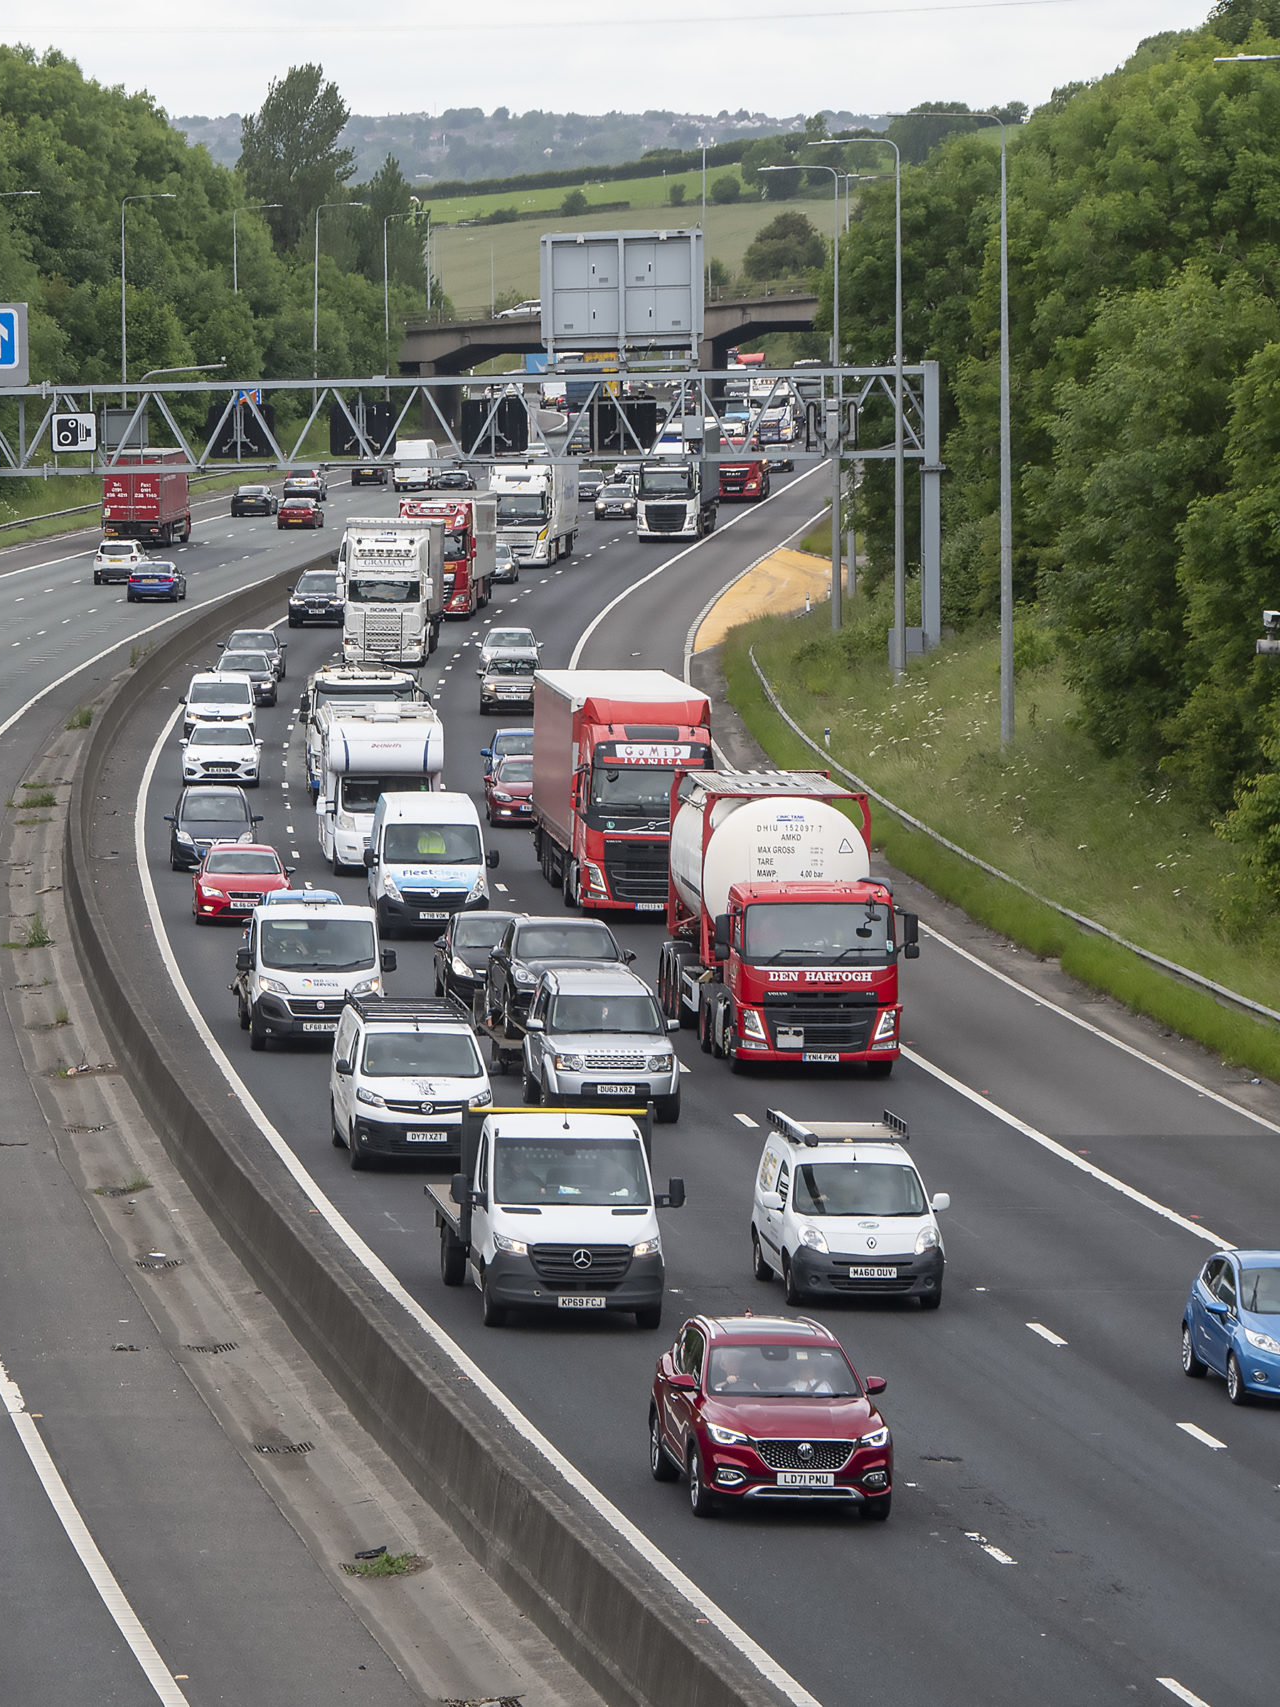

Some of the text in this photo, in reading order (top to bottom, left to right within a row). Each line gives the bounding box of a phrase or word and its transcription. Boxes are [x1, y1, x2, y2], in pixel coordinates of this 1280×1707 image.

[757, 846, 795, 854] MAX GROSS
[768, 971, 873, 982] DEN HARTOGH
[853, 1267, 876, 1276] MA60
[562, 1298, 602, 1306] KP69 FCJ
[784, 1474, 806, 1484] LD71
